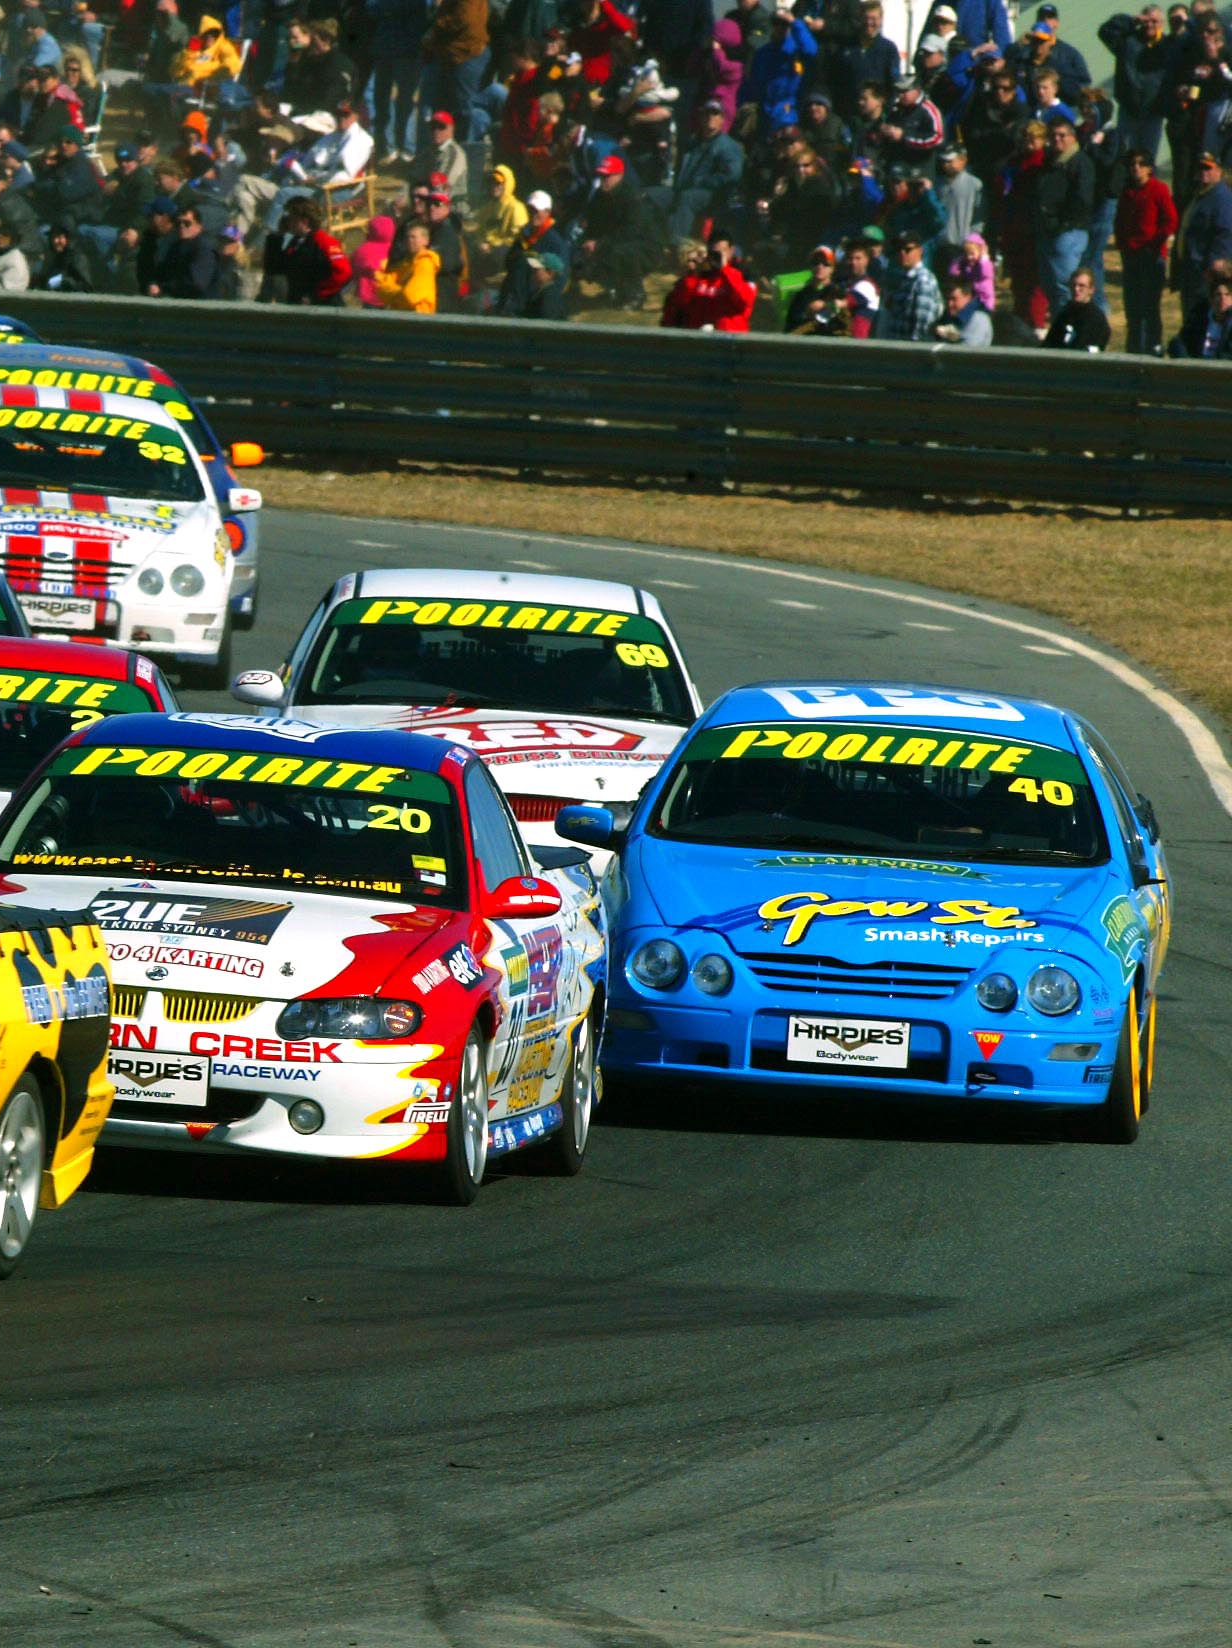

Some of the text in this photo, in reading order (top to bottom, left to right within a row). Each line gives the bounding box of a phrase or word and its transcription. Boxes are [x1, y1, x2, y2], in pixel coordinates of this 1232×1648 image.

[138, 441, 186, 464] 32
[359, 600, 630, 637] POOLRITE
[616, 643, 670, 669] 69
[484, 750, 668, 767] PRESS DELIVE
[721, 729, 1033, 773] POOLRITE
[69, 748, 408, 794] POOLRITE
[1007, 777, 1074, 806] 40
[367, 804, 432, 834] 20
[790, 855, 962, 874] CLARENDON
[91, 899, 208, 926] 2UE
[160, 922, 231, 938] SYDNEY
[234, 930, 269, 944] 954
[864, 927, 1046, 948] Smash Repairs
[132, 945, 156, 962] 4
[155, 947, 265, 979] KARTING
[793, 1022, 905, 1046] HIPPIES
[976, 1032, 1001, 1044] TOW
[189, 1031, 344, 1063] CREEK
[816, 1050, 879, 1062] Bodywear
[212, 1062, 321, 1082] RACEWAY
